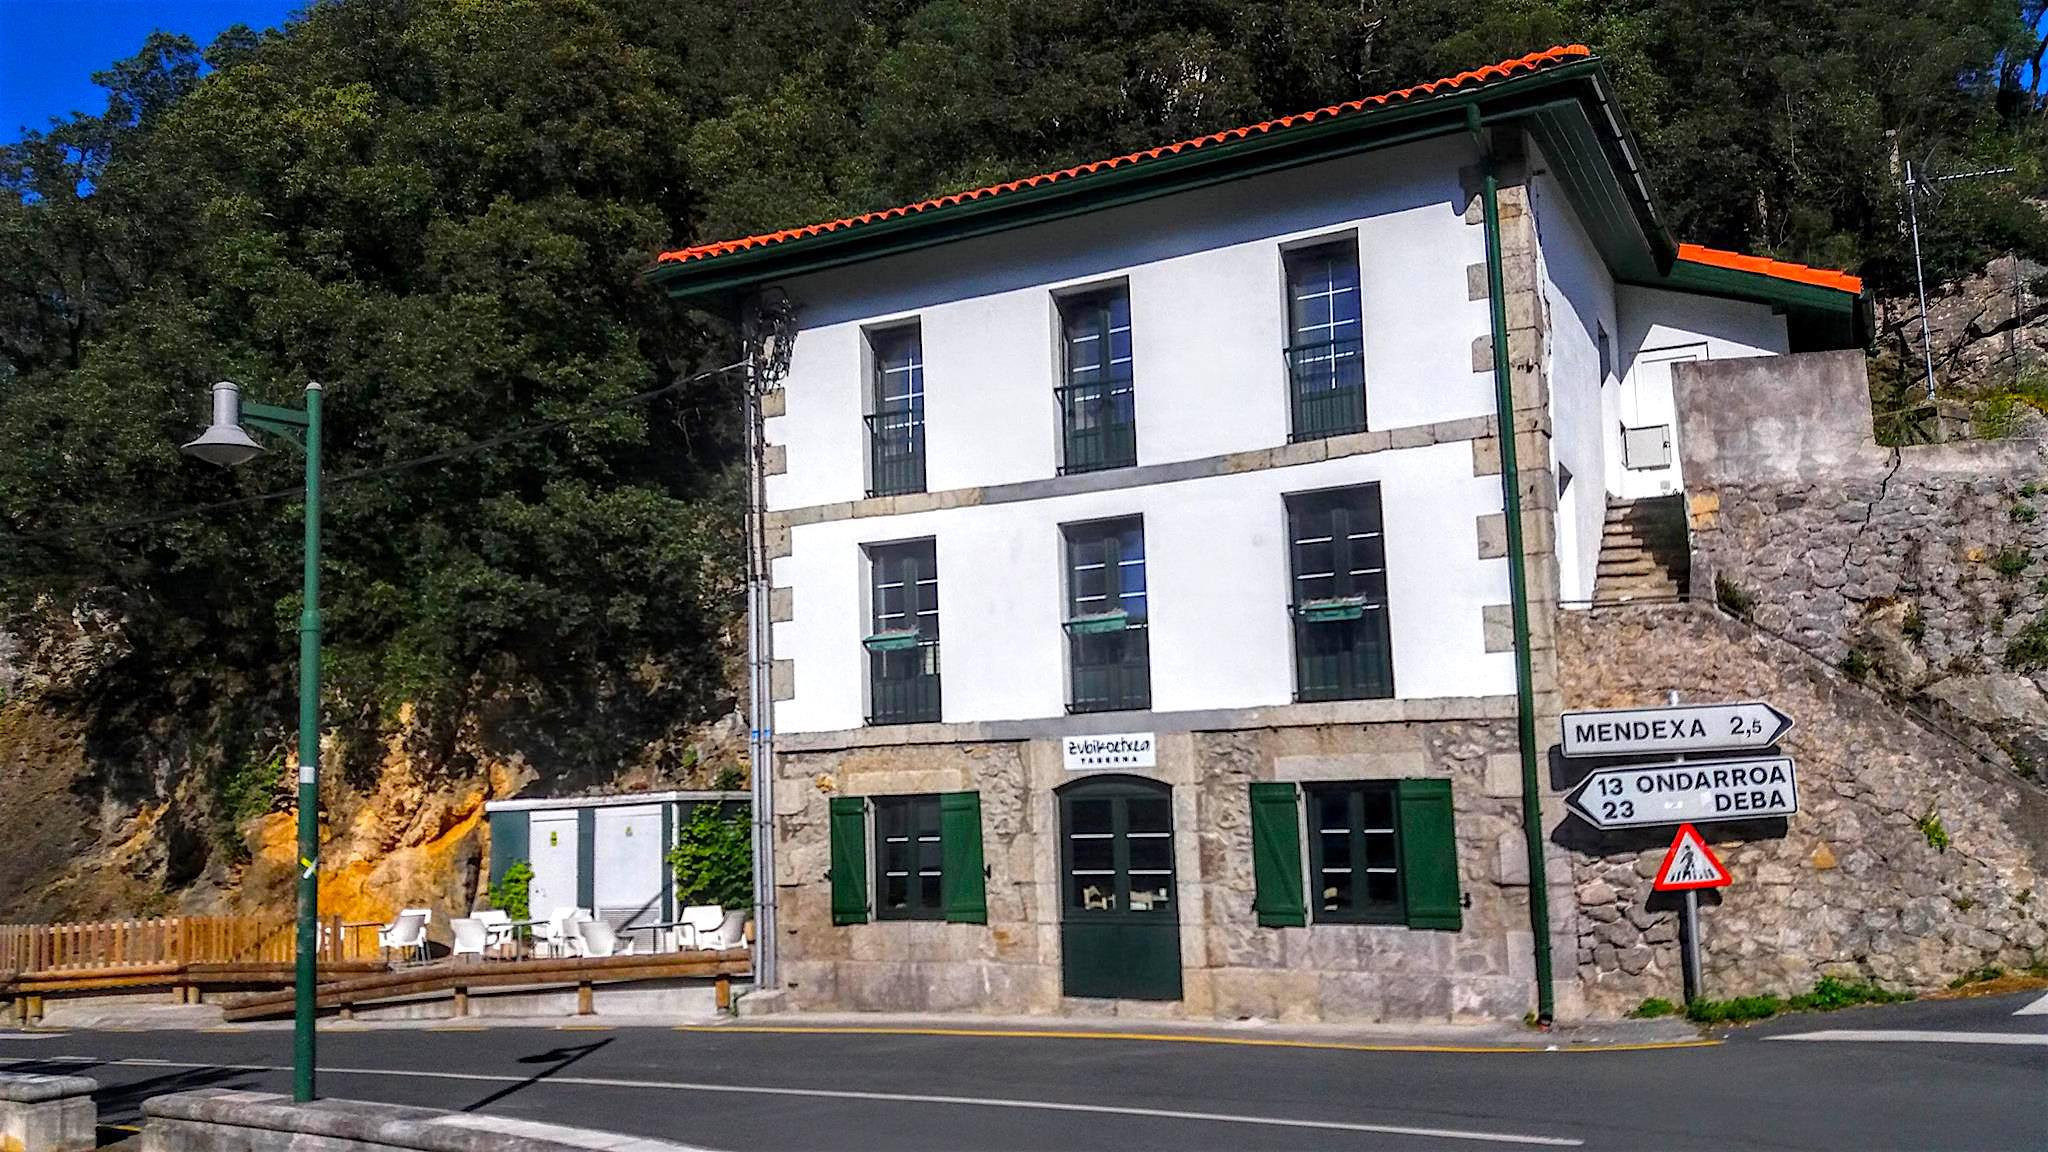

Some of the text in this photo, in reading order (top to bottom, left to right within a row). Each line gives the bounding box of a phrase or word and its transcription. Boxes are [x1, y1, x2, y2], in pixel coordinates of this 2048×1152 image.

[1575, 716, 1762, 743] MENDEXA 2,5
[1597, 765, 1787, 797] 13 ONDARROA
[1602, 789, 1787, 820] 23 DEBA
